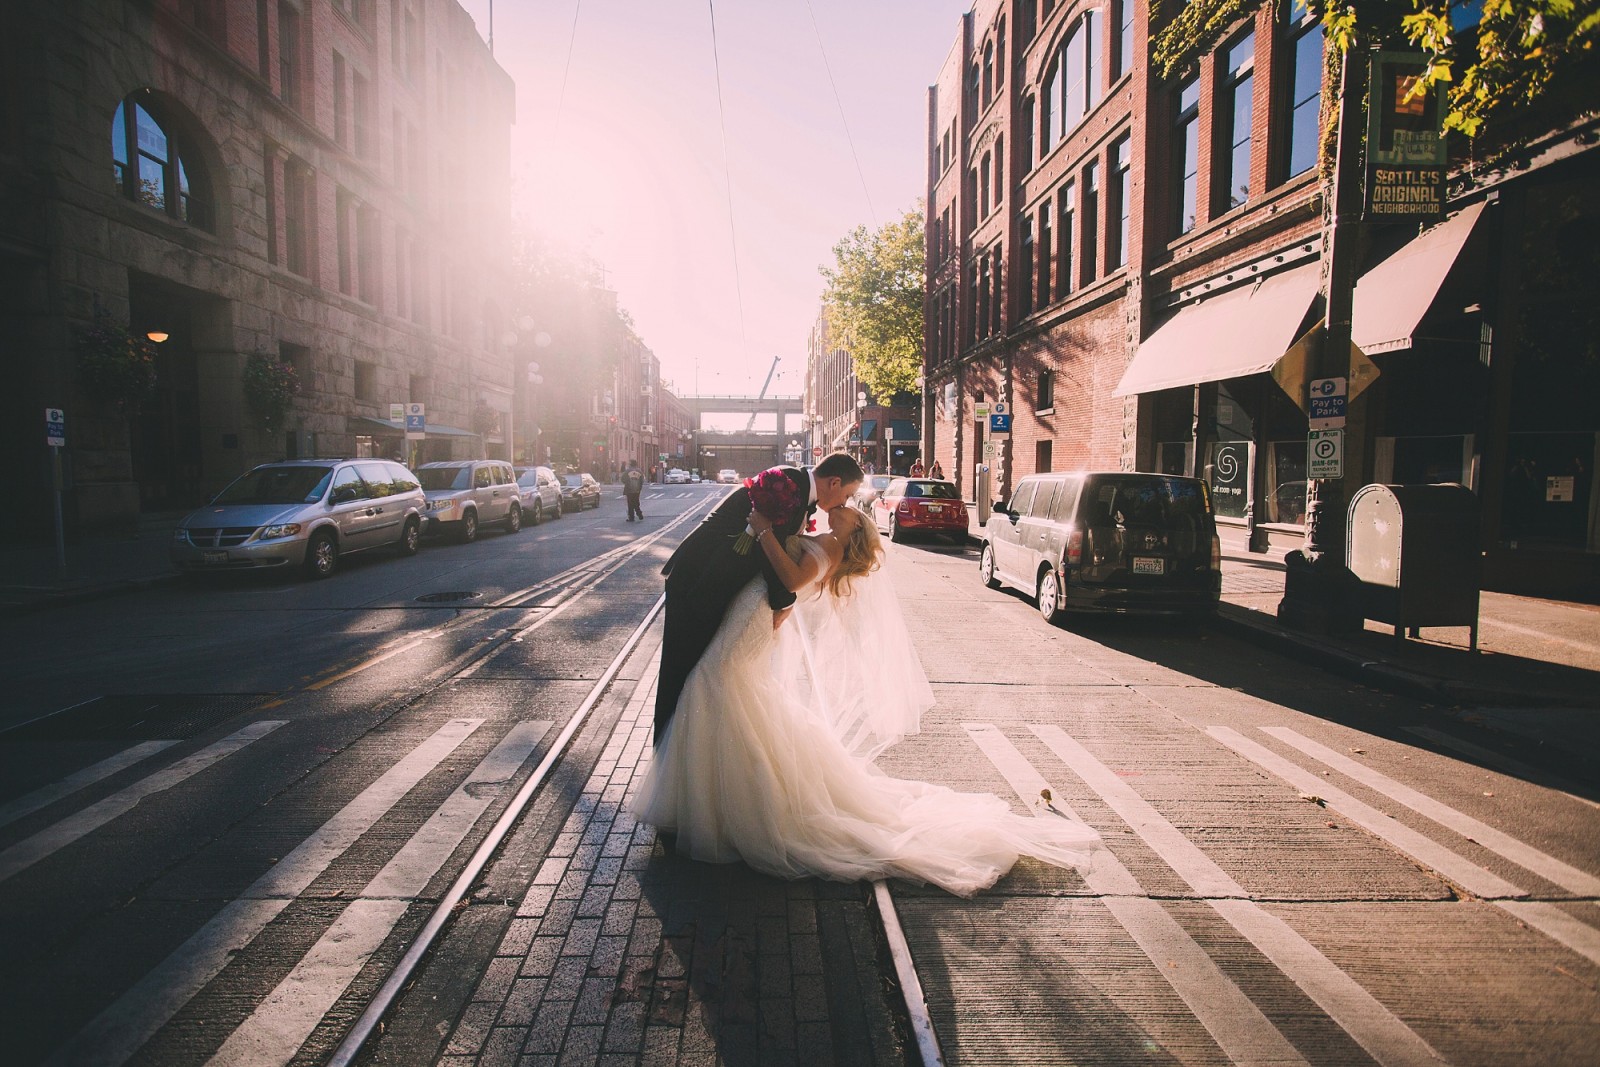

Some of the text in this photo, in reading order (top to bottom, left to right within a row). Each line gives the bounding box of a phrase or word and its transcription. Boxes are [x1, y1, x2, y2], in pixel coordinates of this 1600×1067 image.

[1375, 169, 1440, 185] SEATTLE'S
[1372, 186, 1440, 202] ORIGINAL
[1371, 203, 1440, 214] NEIGHBORHOOD
[1312, 398, 1344, 408] Pay to
[1316, 407, 1339, 416] Park
[412, 417, 419, 425] 2
[997, 416, 1003, 425] 2
[1321, 443, 1331, 455] P
